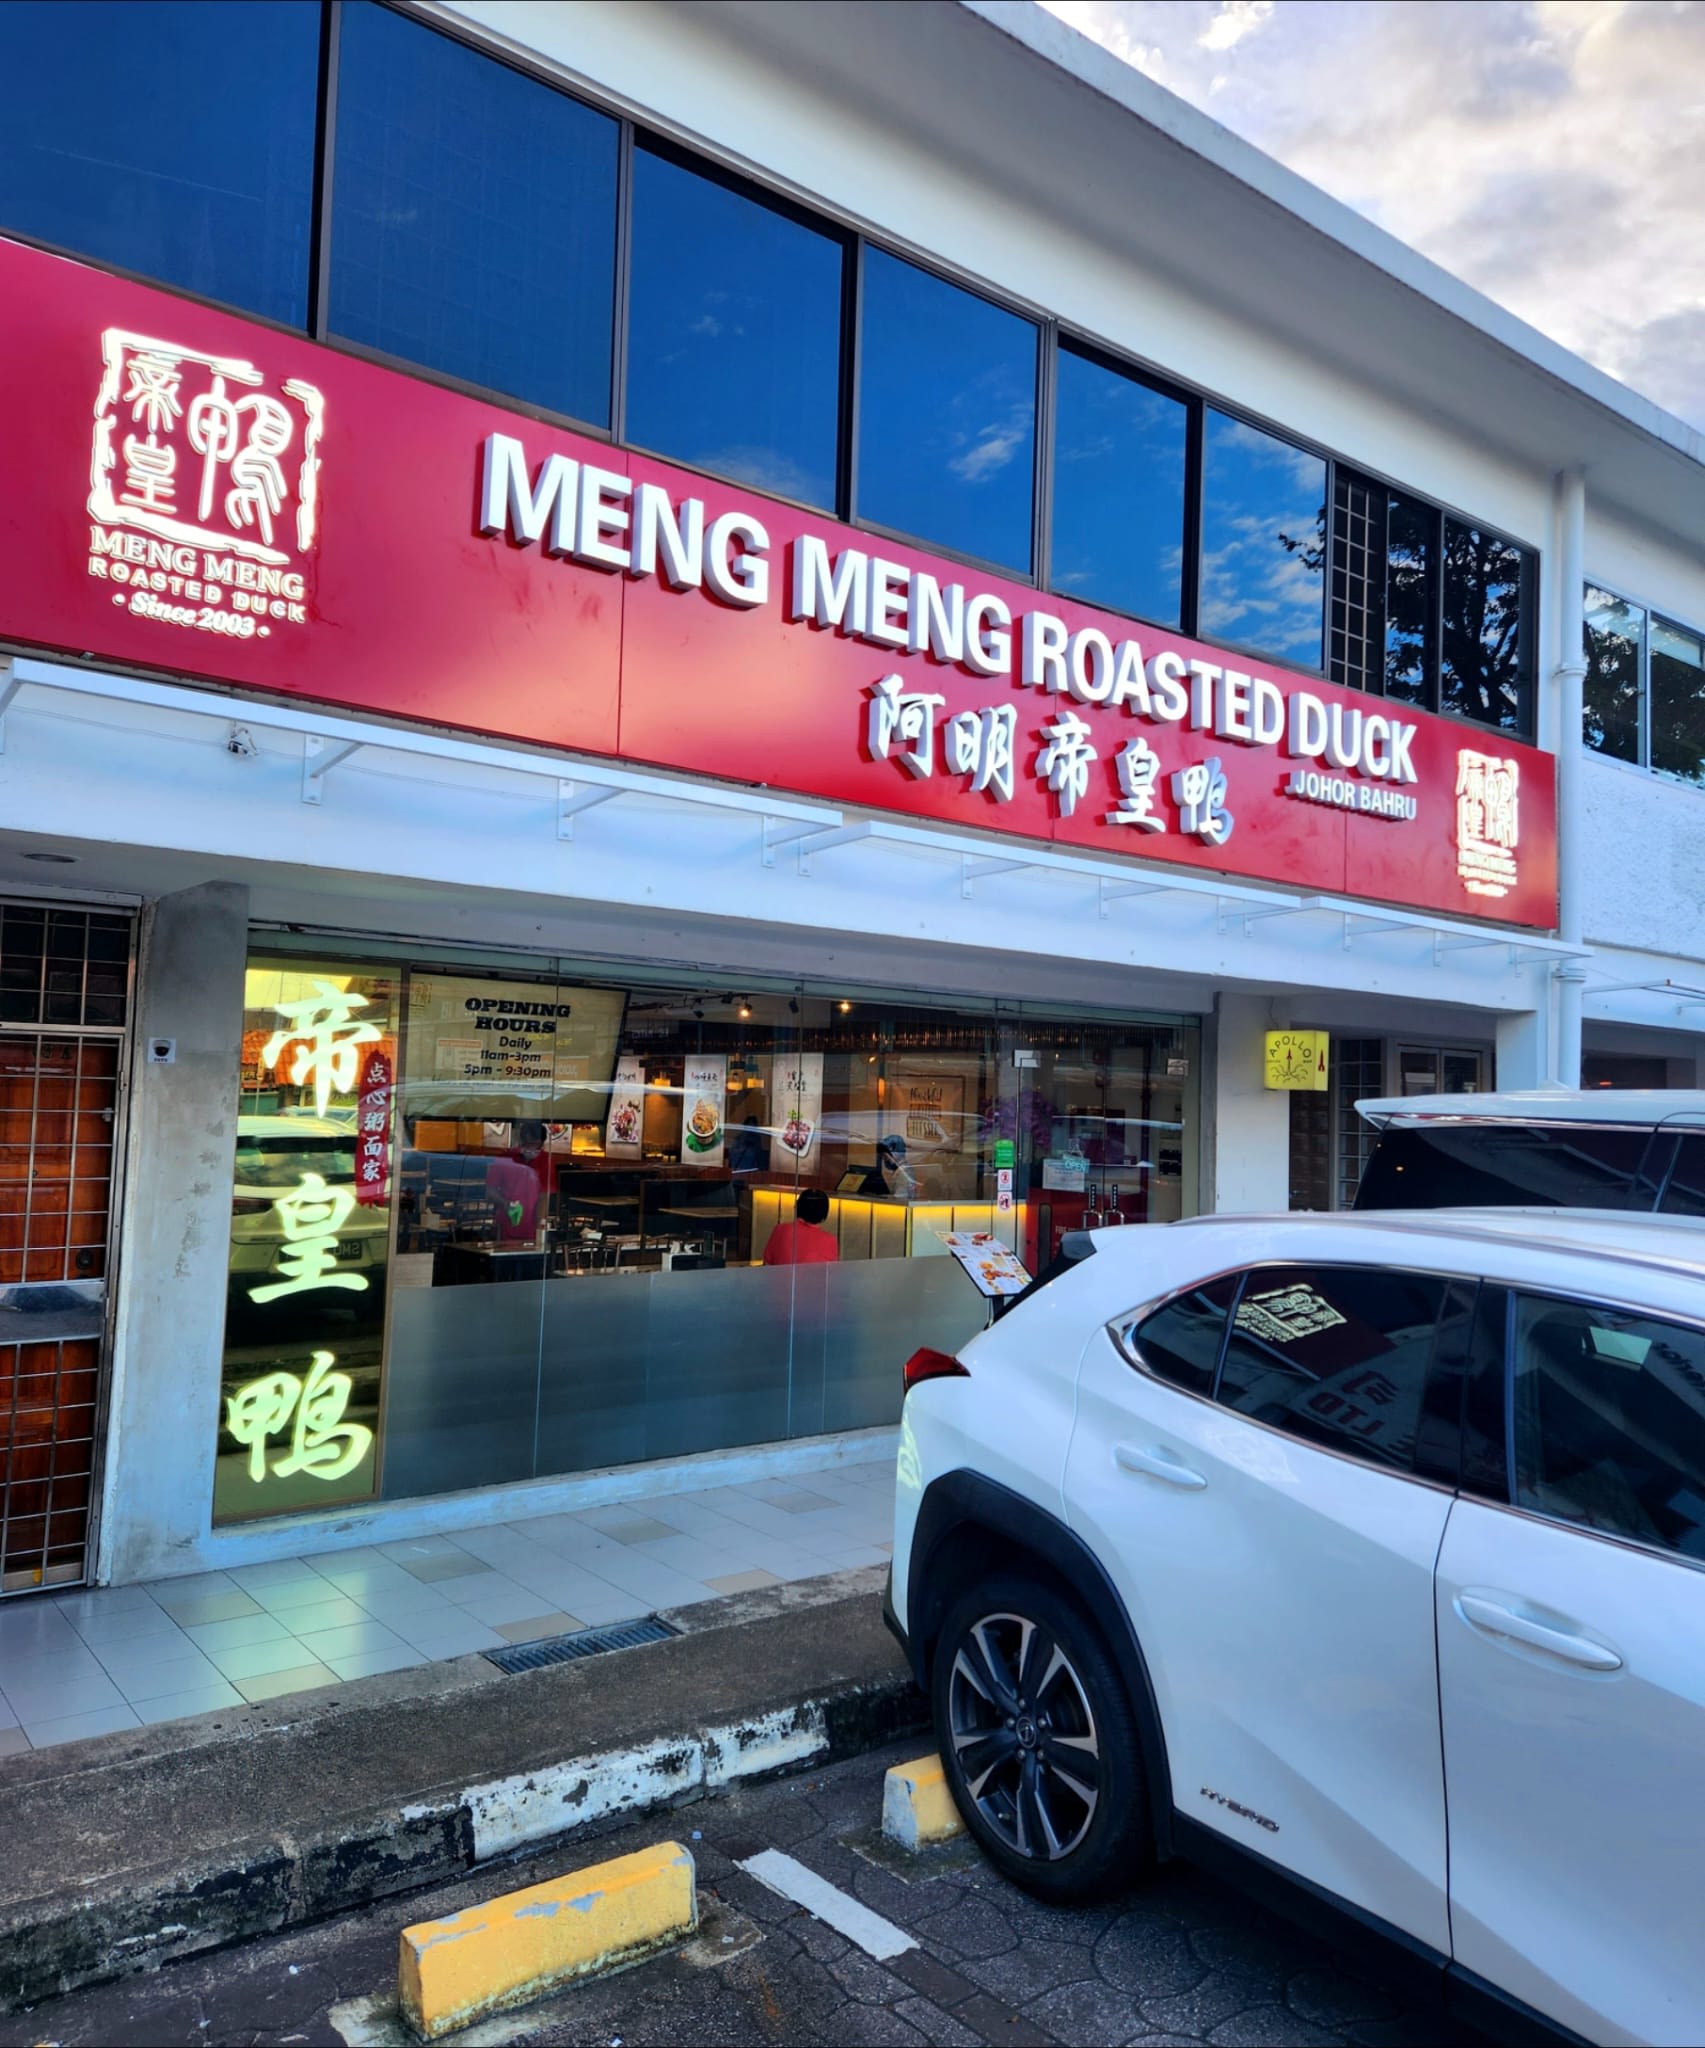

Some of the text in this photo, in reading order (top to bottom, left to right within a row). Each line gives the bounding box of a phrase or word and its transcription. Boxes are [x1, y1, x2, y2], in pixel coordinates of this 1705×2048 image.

[89, 525, 305, 600] MENG MENG
[88, 556, 305, 624] ROASTED DUCK
[479, 431, 1419, 784] MENG MENG ROASTED DUCK
[128, 590, 256, 639] Since 2003
[868, 673, 1234, 846] 阿明帝皇鸭
[1286, 769, 1356, 809] JOHOR
[1359, 785, 1417, 820] BAHRU
[465, 997, 571, 1018] OPENING
[475, 1016, 556, 1034] HOURS
[480, 1049, 541, 1063] 11am-3pm
[499, 1036, 532, 1050] Daily
[1269, 1035, 1312, 1058] APOLLO
[464, 1063, 492, 1076] 5pm
[505, 1065, 551, 1080] 9:30pm
[362, 1061, 387, 1182] 点心粥面家
[1064, 1159, 1088, 1174] OPEN
